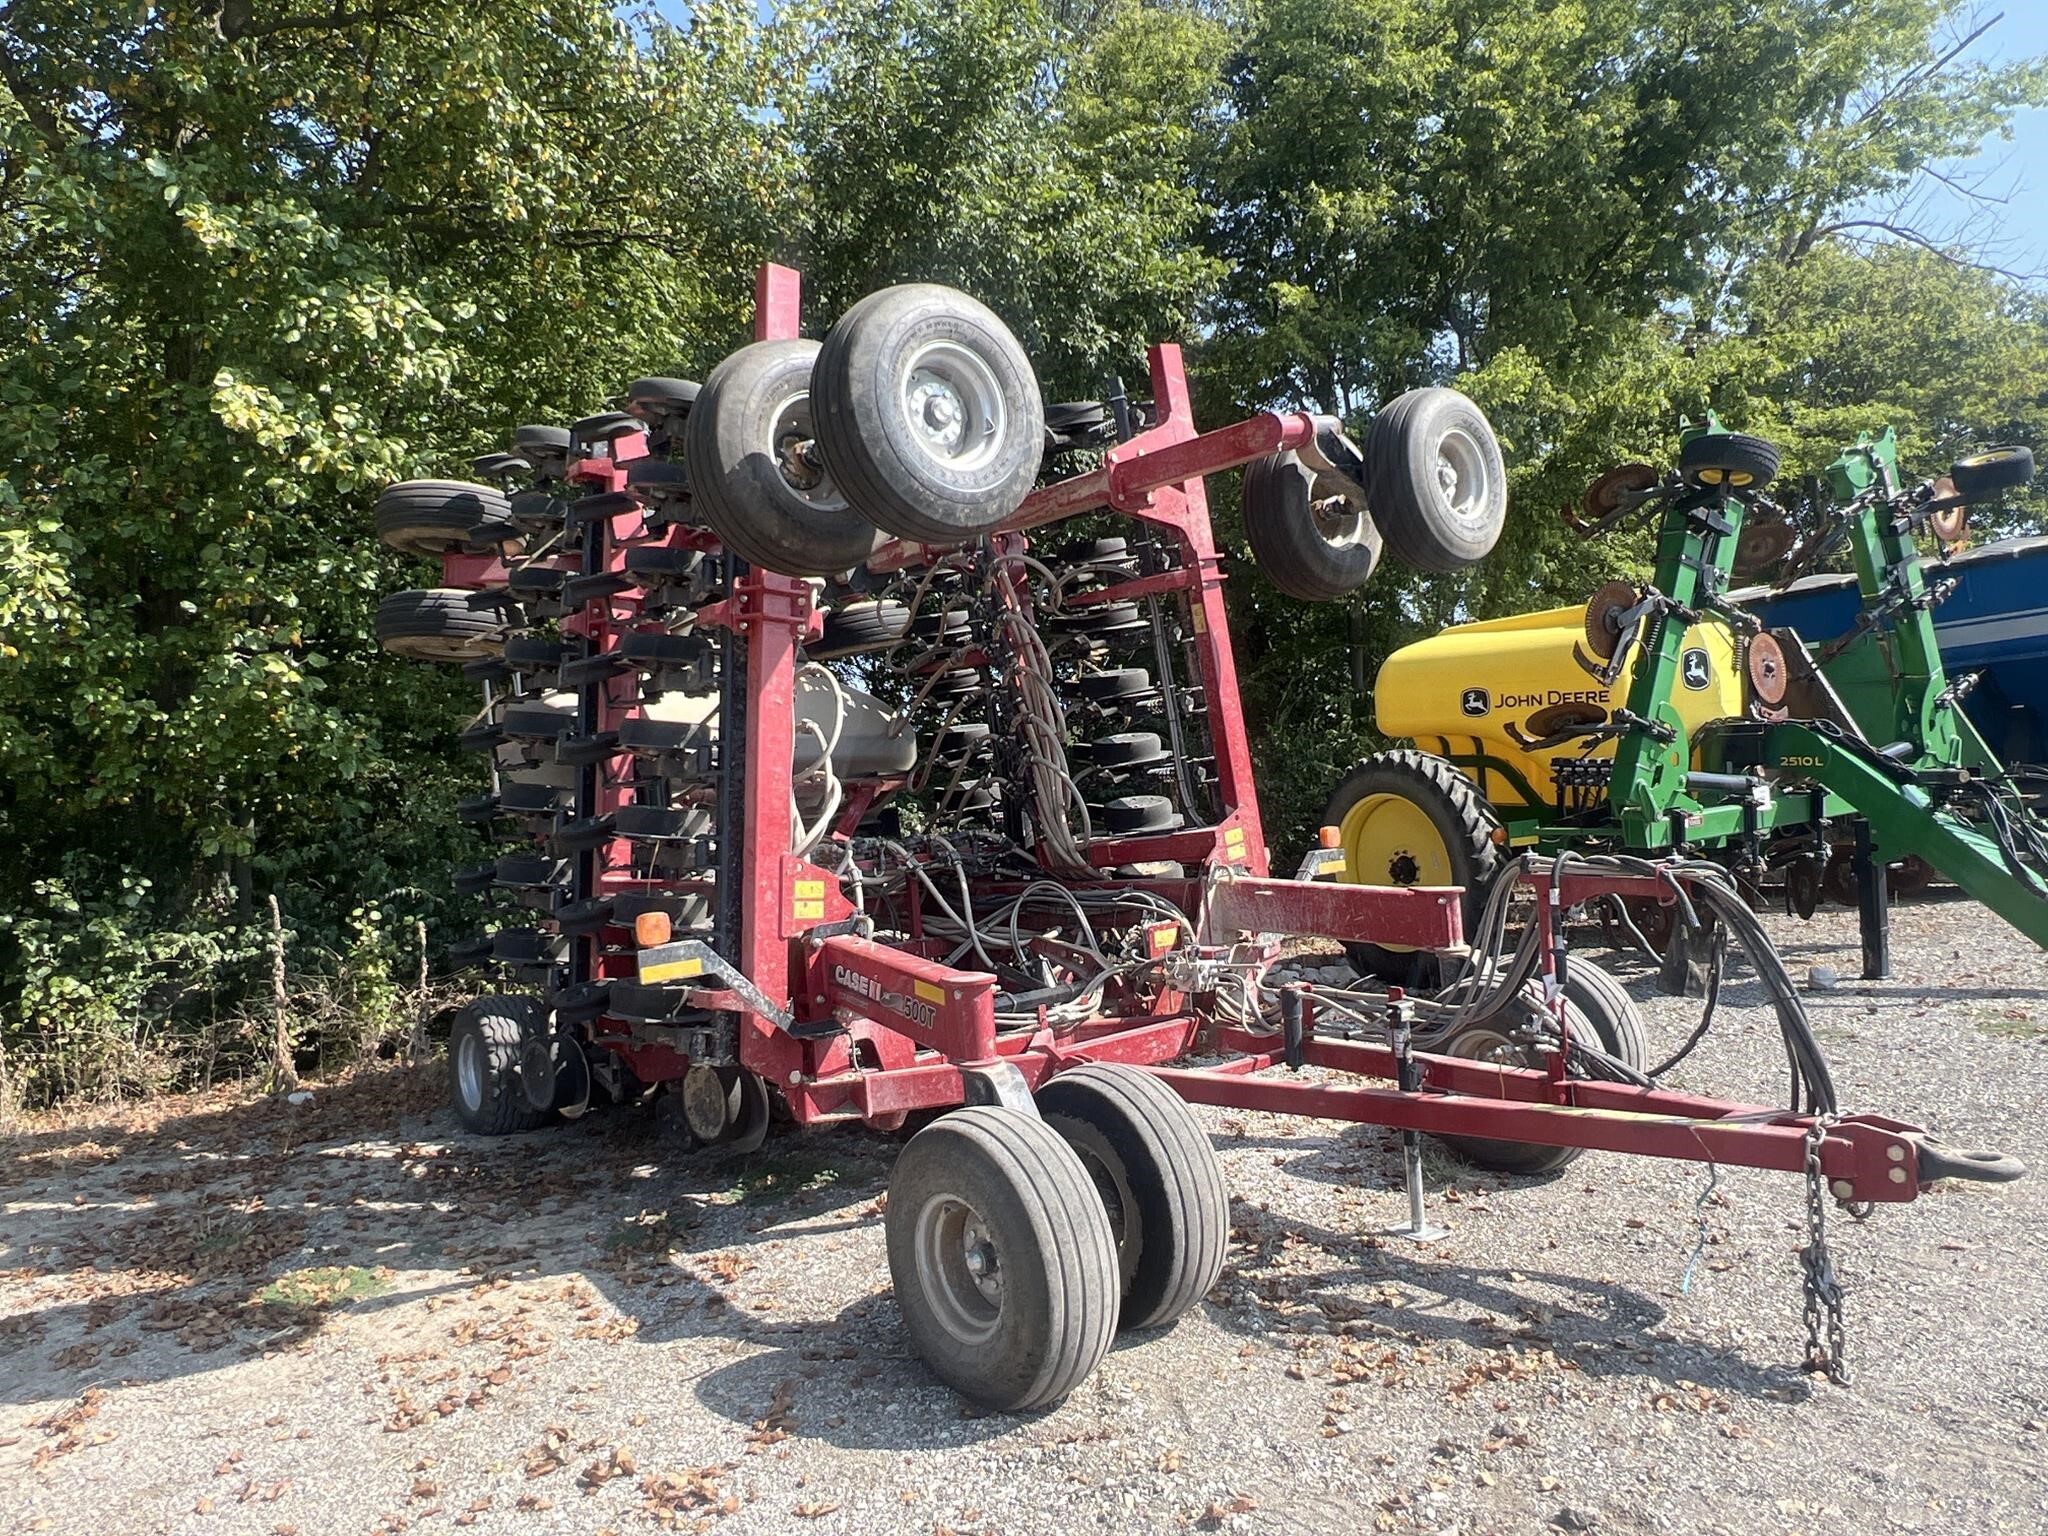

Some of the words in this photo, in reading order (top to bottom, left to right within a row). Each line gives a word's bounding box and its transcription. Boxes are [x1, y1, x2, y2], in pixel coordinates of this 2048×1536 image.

[1494, 693, 1543, 709] JOHN
[1547, 690, 1611, 706] DEERE
[835, 965, 869, 996] CASE
[904, 995, 936, 1029] 500T
